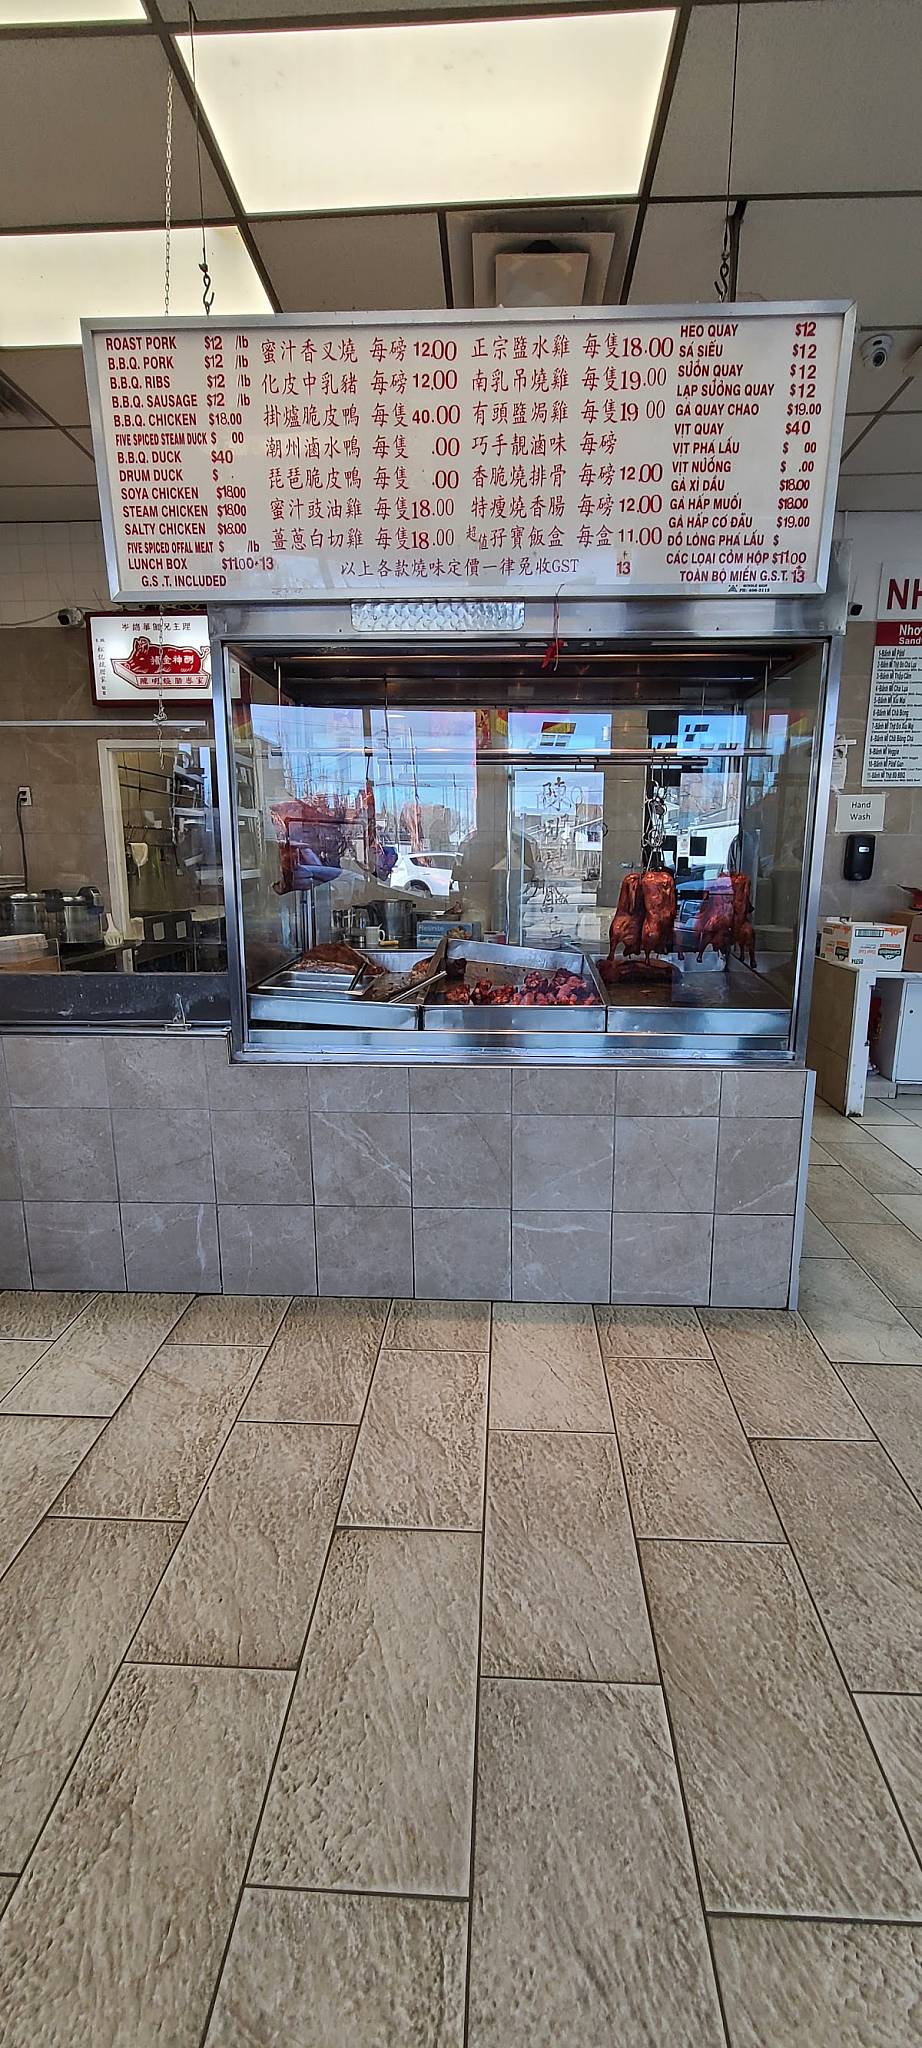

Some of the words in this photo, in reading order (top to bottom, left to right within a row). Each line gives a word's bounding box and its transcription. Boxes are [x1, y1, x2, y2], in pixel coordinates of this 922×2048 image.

[680, 323, 705, 338] HEO
[706, 322, 739, 337] QUAY
[795, 320, 816, 337] $12
[104, 335, 142, 351] ROAST
[144, 334, 178, 350] PORK
[202, 334, 223, 351] $12
[234, 334, 250, 350] /lb
[260, 336, 358, 364] 蜜汁香叉燒
[369, 336, 407, 363] 每磅
[413, 340, 457, 361] 12.00
[582, 333, 620, 359] 每隻
[622, 337, 674, 358] 18.00
[792, 343, 817, 359] $12
[107, 356, 140, 370] B.B.Q.
[143, 354, 176, 371] PORK
[204, 354, 223, 370] $12
[235, 353, 248, 370] /lb
[581, 366, 619, 391] 每隻
[620, 367, 666, 391] 19.00
[713, 364, 743, 378] QUAY
[790, 363, 816, 380] $12
[110, 376, 142, 390] B.B.Q.
[145, 374, 172, 390] RIBS
[207, 374, 225, 389] $12
[238, 374, 251, 388] /lb
[370, 369, 407, 395] 每磅
[413, 369, 457, 392] 12.00
[744, 384, 774, 397] QUAY
[790, 383, 816, 399] $12
[112, 395, 144, 408] B.B.Q.
[147, 394, 198, 409] SAUSAGE
[207, 393, 225, 408] $12
[237, 393, 252, 408] /lb
[695, 402, 725, 416] QUAY
[727, 403, 759, 416] CHAO
[787, 403, 821, 416] $19.00
[371, 402, 408, 428] 每隻
[412, 405, 460, 425] 40.00
[581, 399, 618, 424] 每隻
[113, 414, 145, 429] B.B.Q.
[149, 413, 197, 428] CHICKEN
[209, 412, 242, 428] $18.00
[694, 423, 724, 436] QUAY
[785, 419, 810, 436] $40
[115, 434, 132, 447] FIVE
[133, 433, 159, 446] SPICED
[161, 432, 185, 445] STEAM
[187, 432, 208, 445] DUCK
[372, 434, 409, 459] 每隻
[580, 430, 617, 455] 每磅
[117, 451, 149, 464] B.B.Q.
[152, 450, 182, 463] DUCK
[209, 450, 233, 465] $40
[119, 467, 150, 482] DRUM
[153, 469, 183, 481] DUCK
[373, 466, 410, 490] 每隻
[472, 464, 566, 488] 香脆燒排骨
[579, 462, 615, 487] 每磅
[620, 463, 663, 483] 12.00
[121, 487, 149, 500] SOYA
[150, 486, 199, 500] CHICKEN
[123, 505, 158, 518] STEAM
[161, 504, 208, 518] CHICKEN
[374, 496, 410, 521] 每隻
[411, 498, 454, 520] 18.00
[471, 495, 565, 520] 特瘦燒香腸
[578, 493, 614, 518] 每磅
[619, 494, 662, 514] 12.00
[125, 522, 155, 537] SALTY
[159, 521, 206, 536] CHICKEN
[776, 514, 810, 529] $19.00
[375, 526, 412, 551] 每隻
[409, 529, 454, 550] 18.00
[576, 524, 614, 548] 每盒
[618, 527, 662, 546] 11.00
[127, 542, 143, 554] FIVE
[144, 542, 169, 554] SPICED
[171, 541, 193, 555] OFFAL
[194, 540, 213, 555] MEAT
[247, 540, 259, 553] /lb
[128, 558, 164, 572] LUNCH
[166, 558, 189, 572] BOX
[174, 574, 226, 589] INCLUDED
[850, 812, 870, 820] Wash
